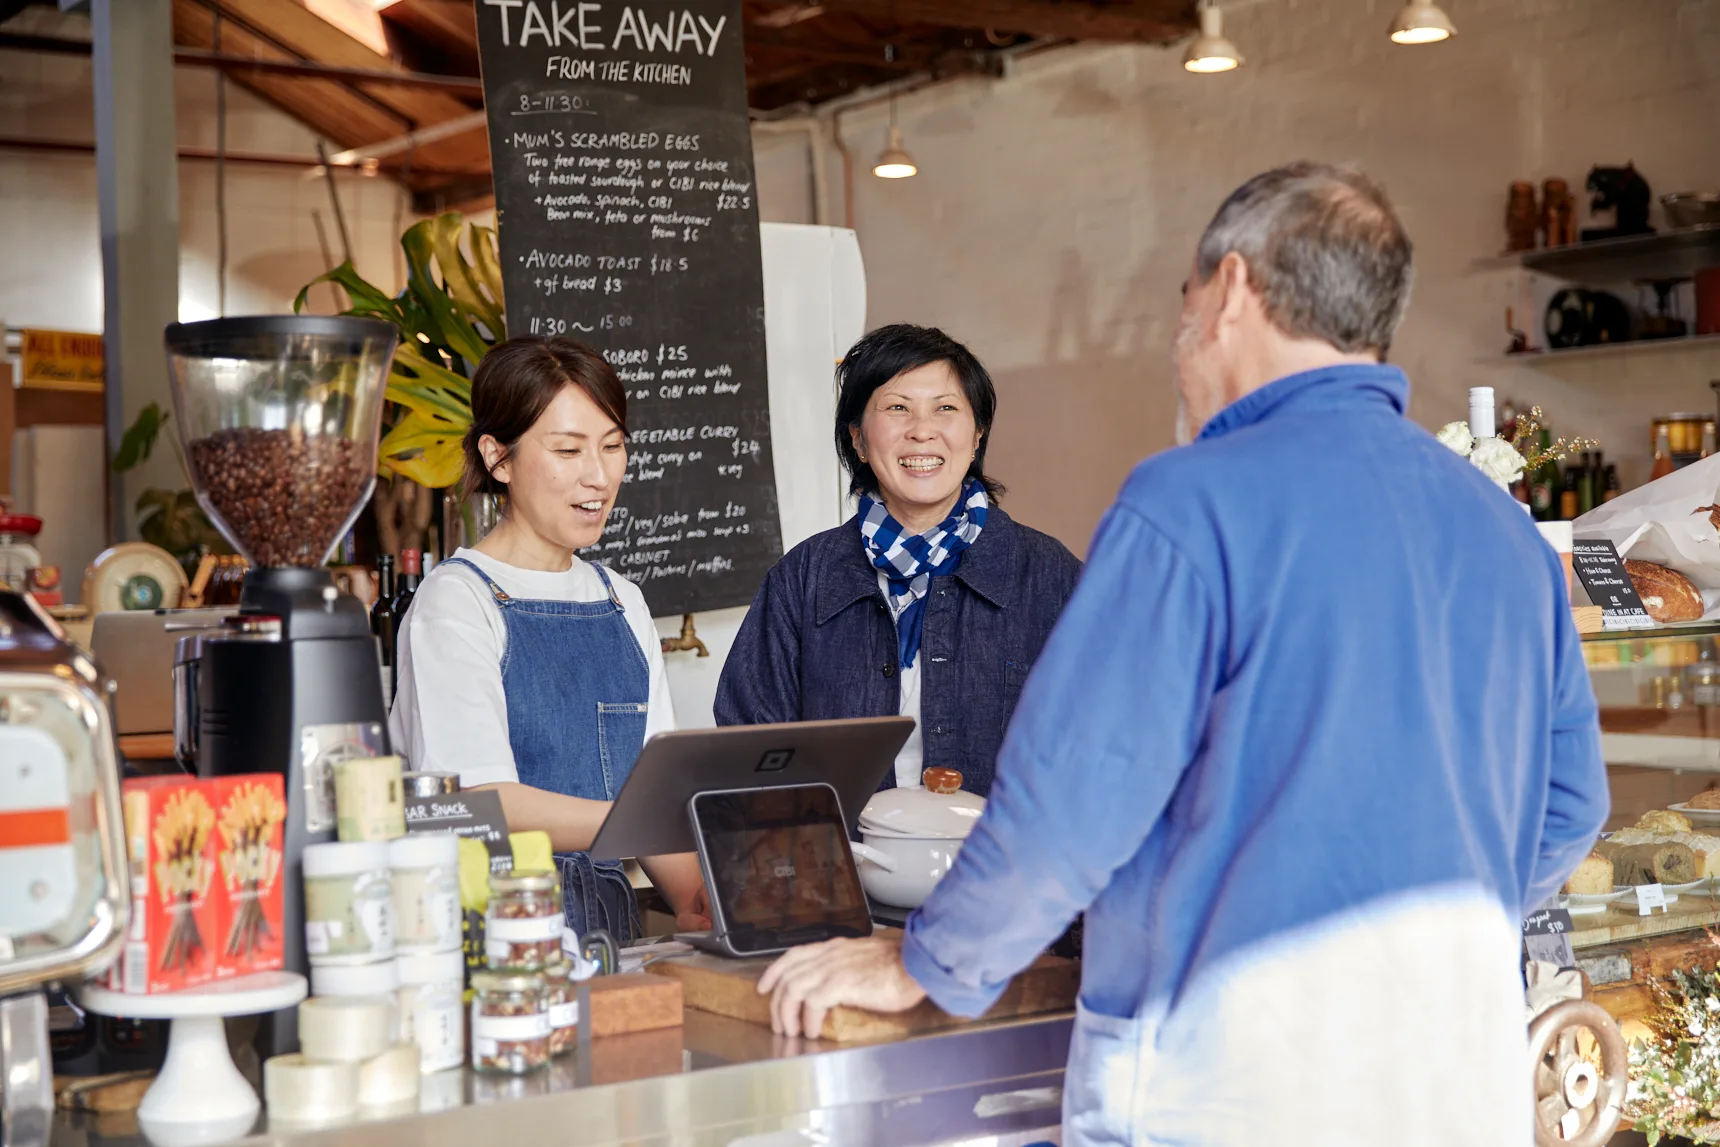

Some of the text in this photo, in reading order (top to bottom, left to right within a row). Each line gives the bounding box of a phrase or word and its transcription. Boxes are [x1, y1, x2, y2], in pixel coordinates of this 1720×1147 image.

[484, 0, 726, 56] TAKE AWAY
[546, 56, 691, 85] FROM THE KITCHEN
[513, 130, 700, 151] MUM'S SCRAMBLED EGGS
[524, 153, 728, 177] Two free range eggs on your choice
[529, 169, 541, 187] of
[549, 172, 587, 185] toasted
[590, 174, 644, 195] sourdough
[651, 178, 663, 189] or
[670, 176, 695, 191] CIBI
[648, 196, 672, 209] CIBI
[634, 214, 647, 224] or
[526, 249, 591, 268] AVOCADO
[598, 256, 642, 270] TOAST
[563, 276, 597, 290] bread
[604, 278, 622, 295] $3
[656, 343, 688, 365] $25
[661, 366, 697, 380] mince
[704, 364, 732, 378] with
[636, 389, 650, 400] on
[659, 385, 684, 399] CIBI
[700, 425, 739, 439] CURRY
[688, 451, 702, 462] on
[725, 501, 747, 518] $20
[620, 549, 671, 567] CABINET
